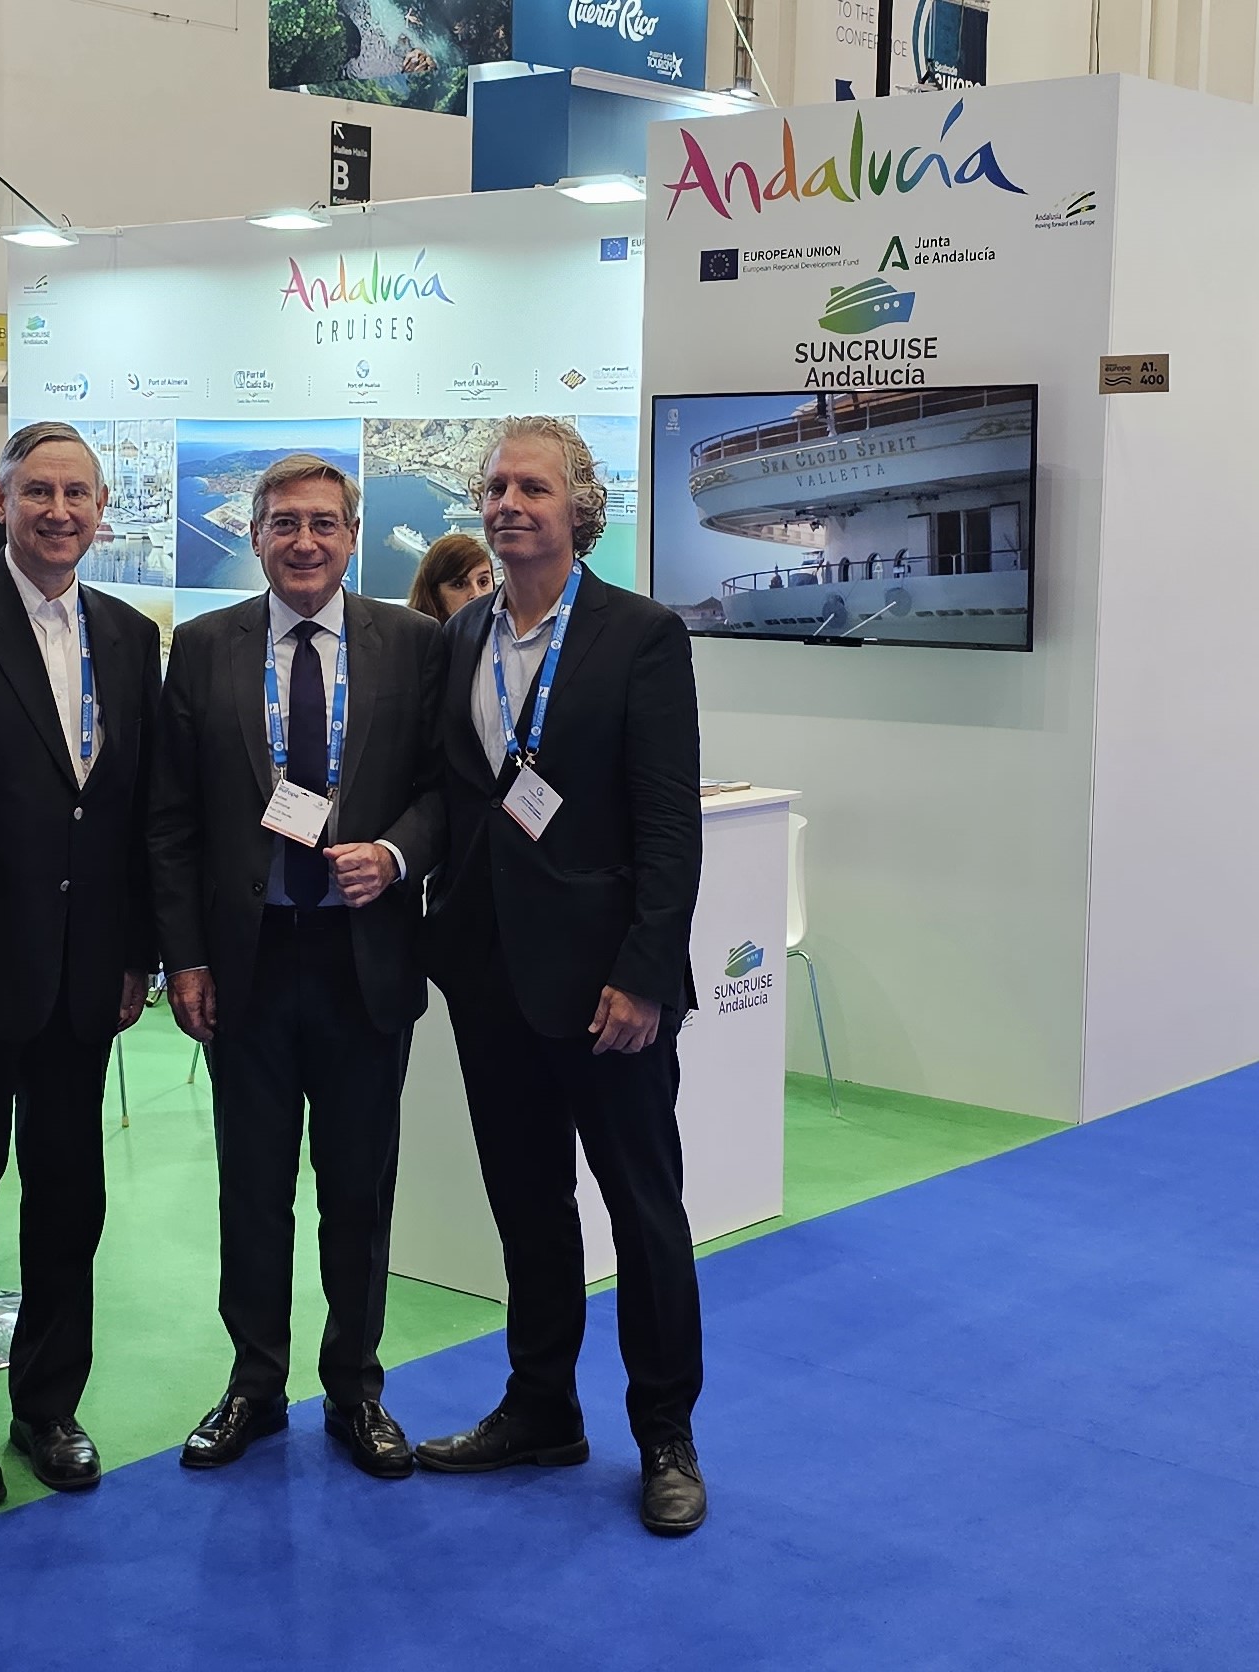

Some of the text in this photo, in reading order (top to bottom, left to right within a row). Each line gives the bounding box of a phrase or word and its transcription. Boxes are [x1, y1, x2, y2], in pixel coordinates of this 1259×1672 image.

[838, 0, 875, 24] TO THE
[836, 26, 907, 57] CONFECE
[663, 97, 1029, 221] Andalucía
[333, 160, 349, 190] B
[744, 246, 840, 262] EUROPEAN UNION
[914, 236, 950, 250] Junta
[914, 246, 996, 264] de Andalucía
[801, 260, 841, 268] Development
[280, 248, 455, 312] Andalucía
[794, 337, 938, 364] SUNCRUISE
[805, 363, 924, 388] Andalucía
[1141, 362, 1158, 372] A1.
[1140, 374, 1164, 385] 400
[796, 464, 885, 487] VALLETTA
[714, 974, 772, 1000] SUNCRUISE
